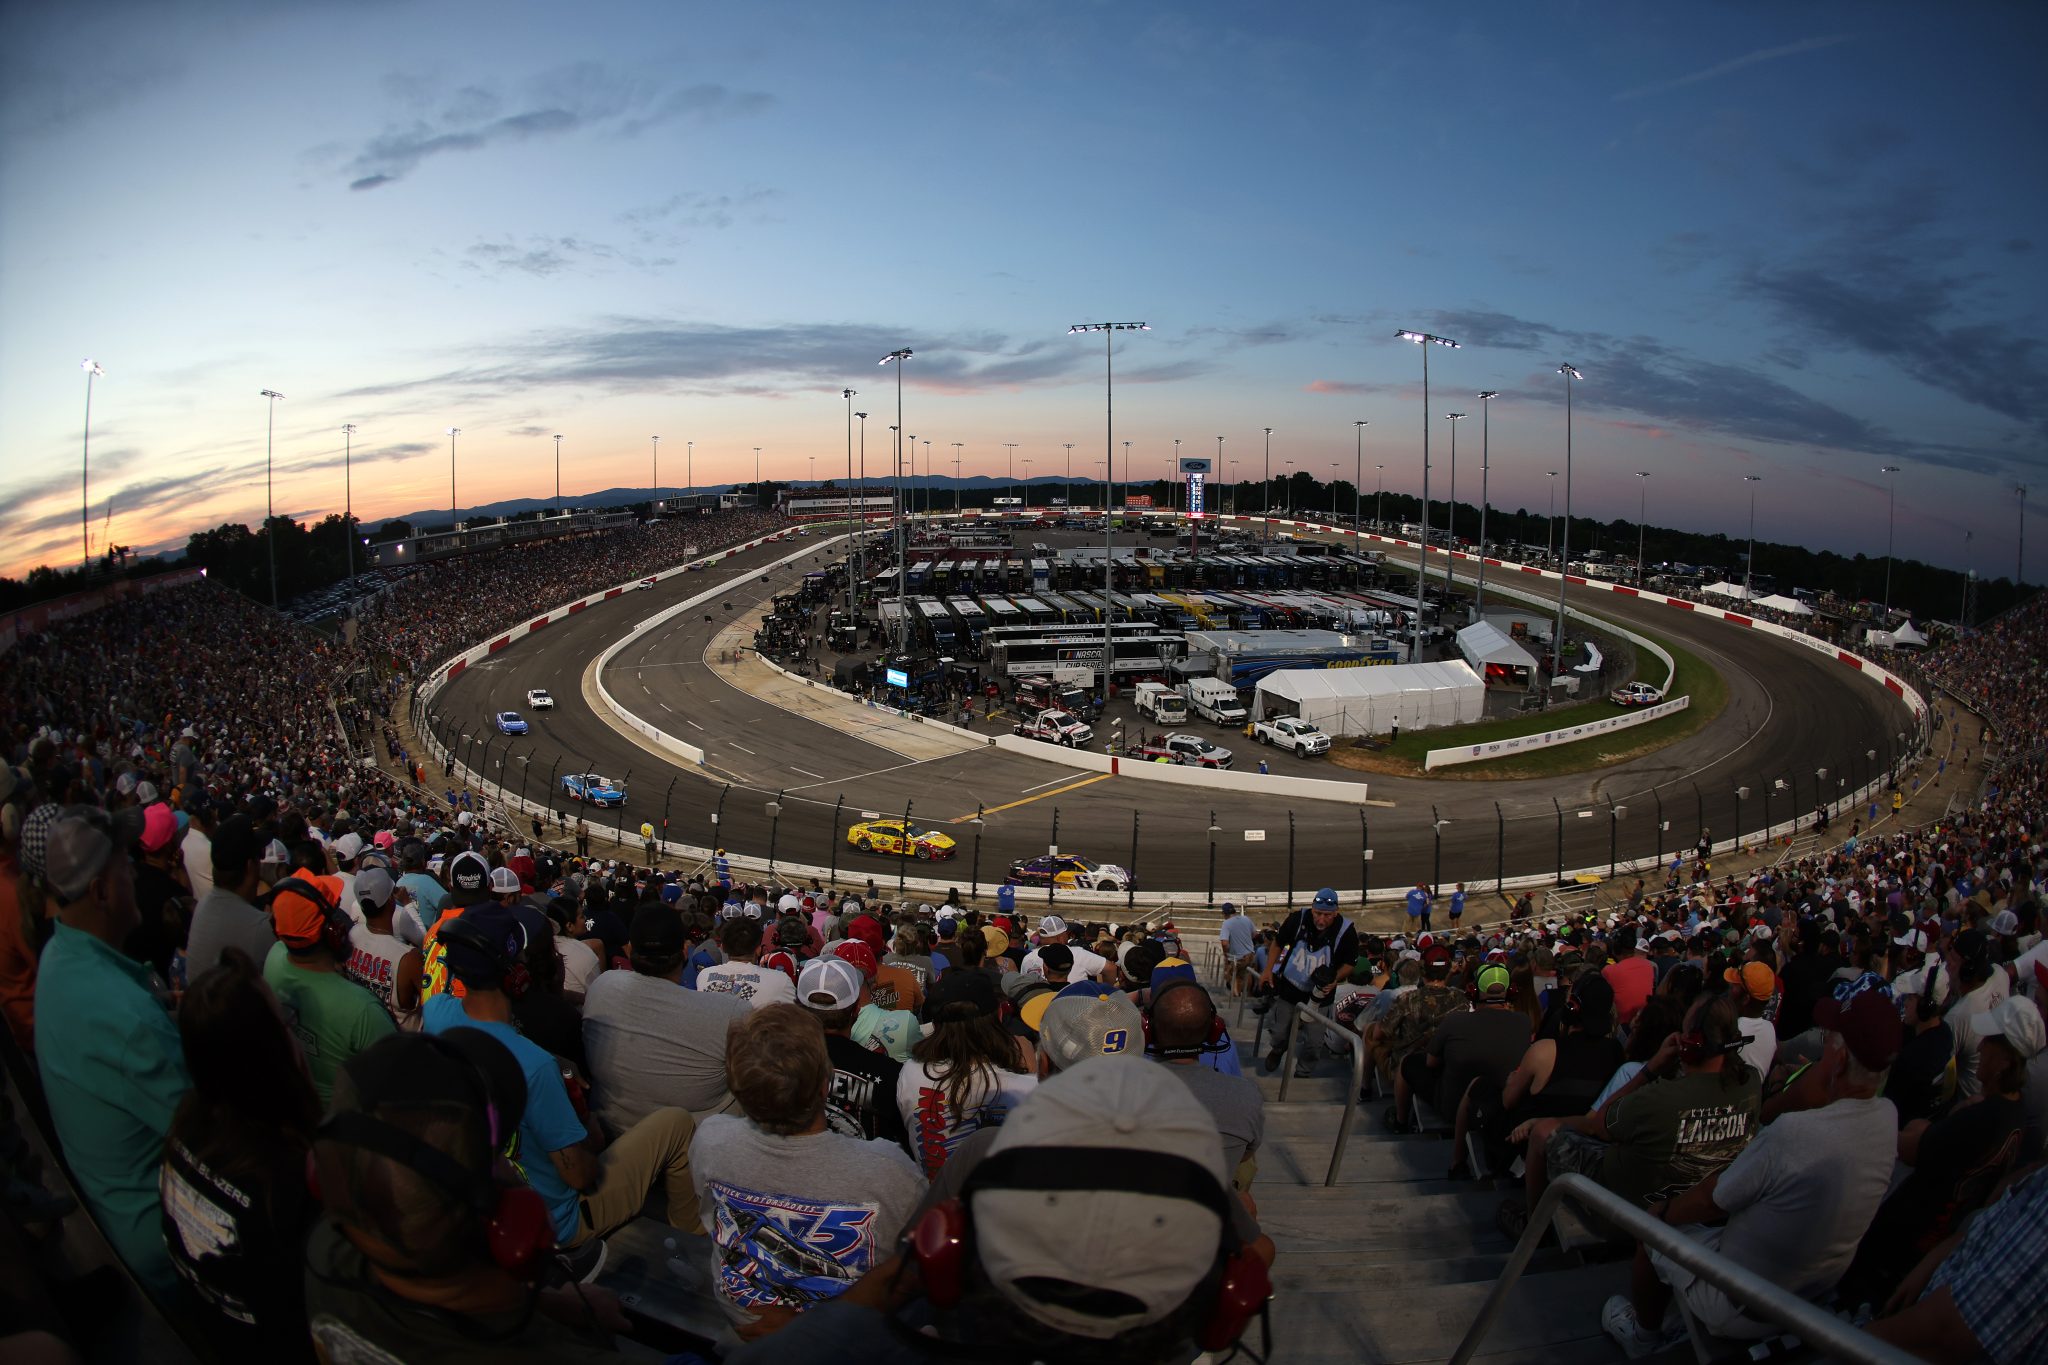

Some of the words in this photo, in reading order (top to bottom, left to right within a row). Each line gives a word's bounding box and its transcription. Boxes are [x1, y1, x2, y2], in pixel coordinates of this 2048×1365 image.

[1075, 650, 1102, 659] NASCA
[1327, 657, 1394, 669] GOODYEAR
[346, 947, 391, 982] HASE
[1336, 992, 1358, 1012] BELL
[1102, 1029, 1128, 1054] 9
[1691, 1106, 1720, 1118] KYLE
[1677, 1112, 1748, 1144] LARSON
[745, 1194, 817, 1213] MOTORSPORTS
[804, 1206, 876, 1258] 5
